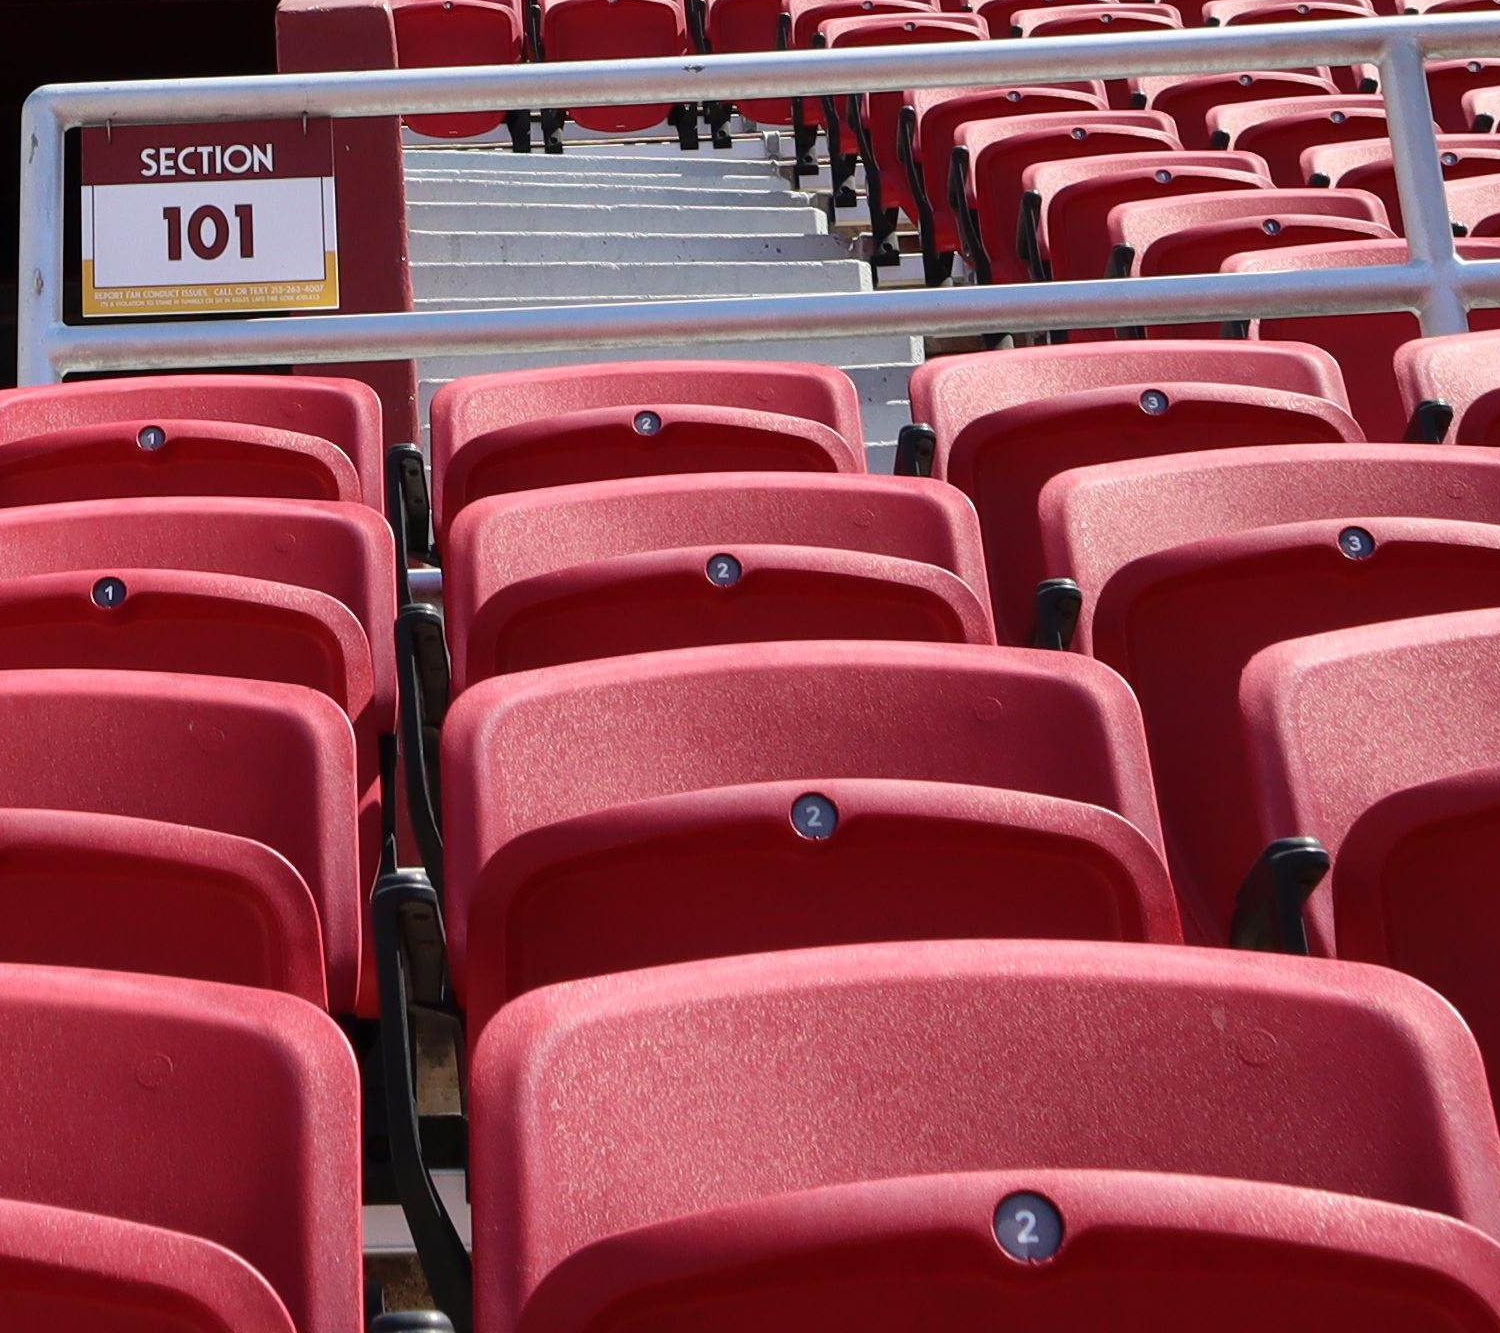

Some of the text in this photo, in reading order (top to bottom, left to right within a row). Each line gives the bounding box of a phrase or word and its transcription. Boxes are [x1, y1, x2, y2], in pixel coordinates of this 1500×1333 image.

[140, 144, 274, 176] SECTION
[163, 204, 254, 261] 101
[125, 290, 141, 299] FAN
[142, 289, 180, 299] CONDUCT
[213, 287, 234, 297] CALL
[235, 287, 248, 296] OR
[250, 286, 269, 295] TEXT
[1147, 396, 1159, 409] 3
[641, 417, 652, 430] 2
[146, 432, 155, 445] 1
[1349, 535, 1362, 552] 3
[717, 562, 730, 579] 2
[104, 584, 114, 601] 1
[805, 805, 823, 827] 2
[1014, 1210, 1040, 1244] 2
